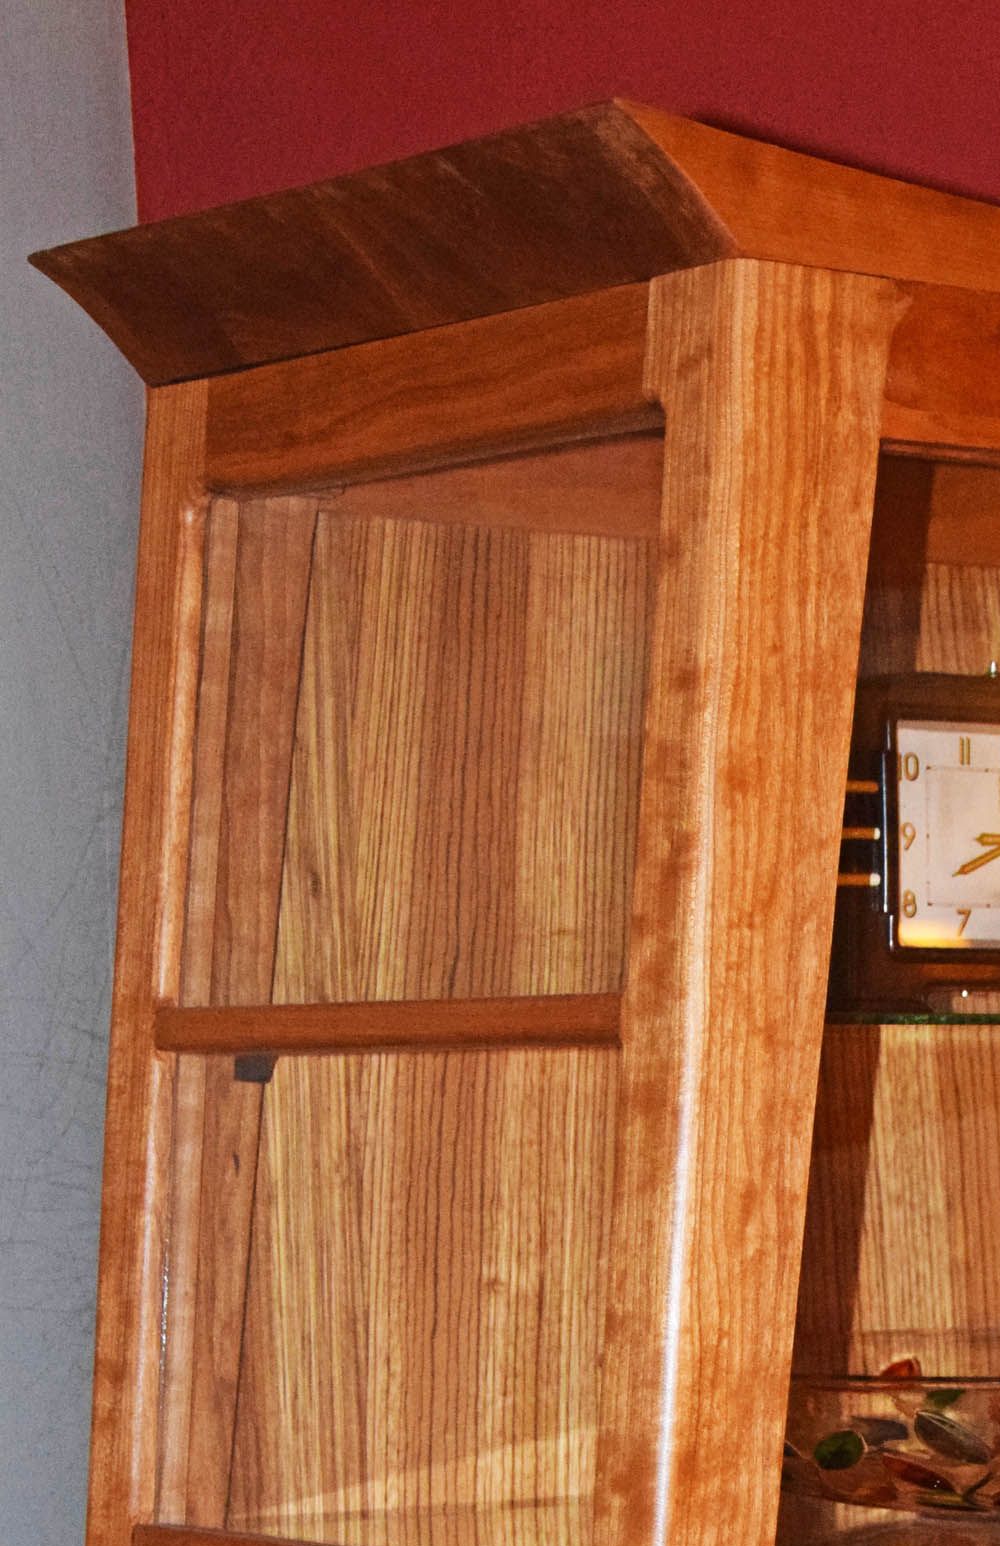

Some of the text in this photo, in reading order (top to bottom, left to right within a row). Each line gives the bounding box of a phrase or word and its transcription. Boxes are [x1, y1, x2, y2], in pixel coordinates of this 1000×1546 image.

[960, 737, 971, 766] 11
[902, 822, 917, 851] 9
[903, 890, 917, 918] 8
[956, 909, 972, 937] 7
